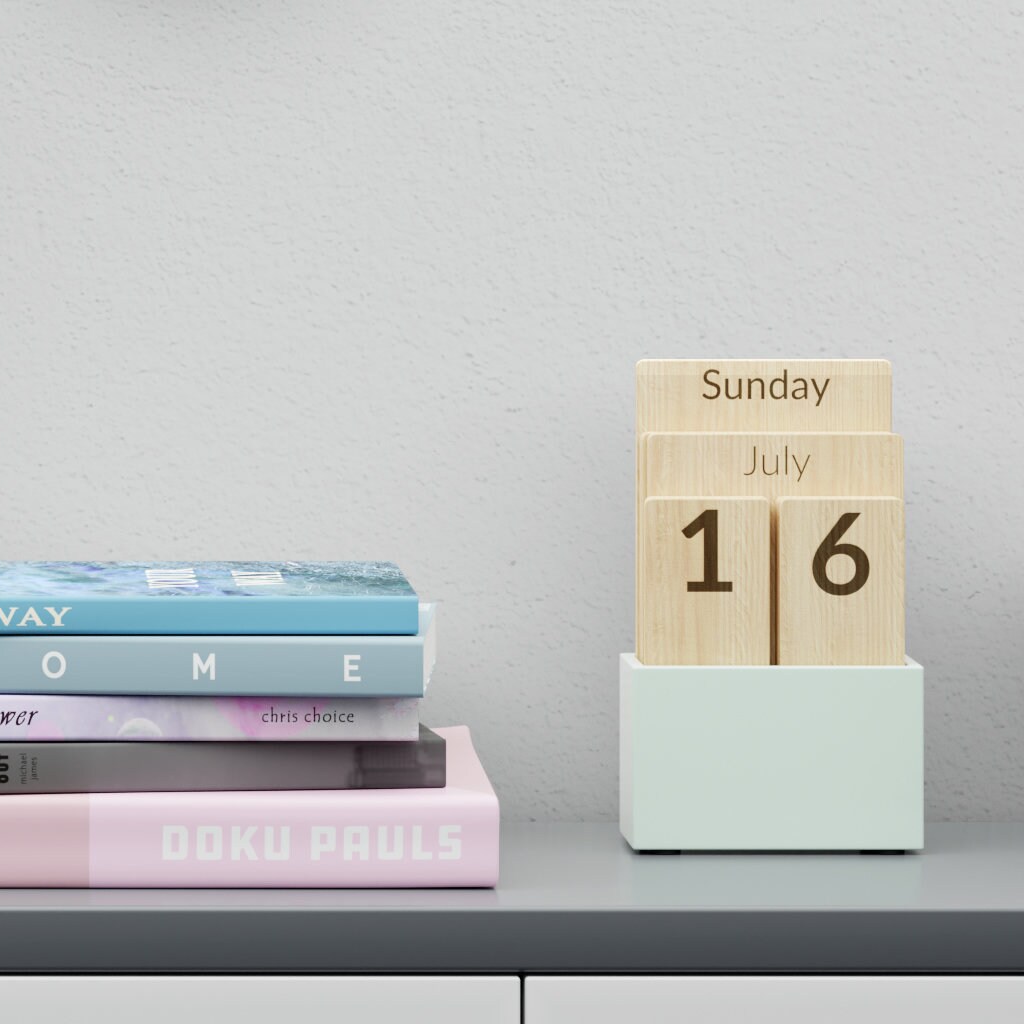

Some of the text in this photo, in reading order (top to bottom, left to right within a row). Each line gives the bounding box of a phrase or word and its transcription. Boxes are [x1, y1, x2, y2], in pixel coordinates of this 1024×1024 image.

[701, 369, 830, 407] Sunday
[743, 446, 811, 483] July
[261, 706, 355, 724] chris choice
[19, 752, 27, 785] michael
[31, 757, 39, 781] james
[162, 825, 463, 861] DOKU PAULS
